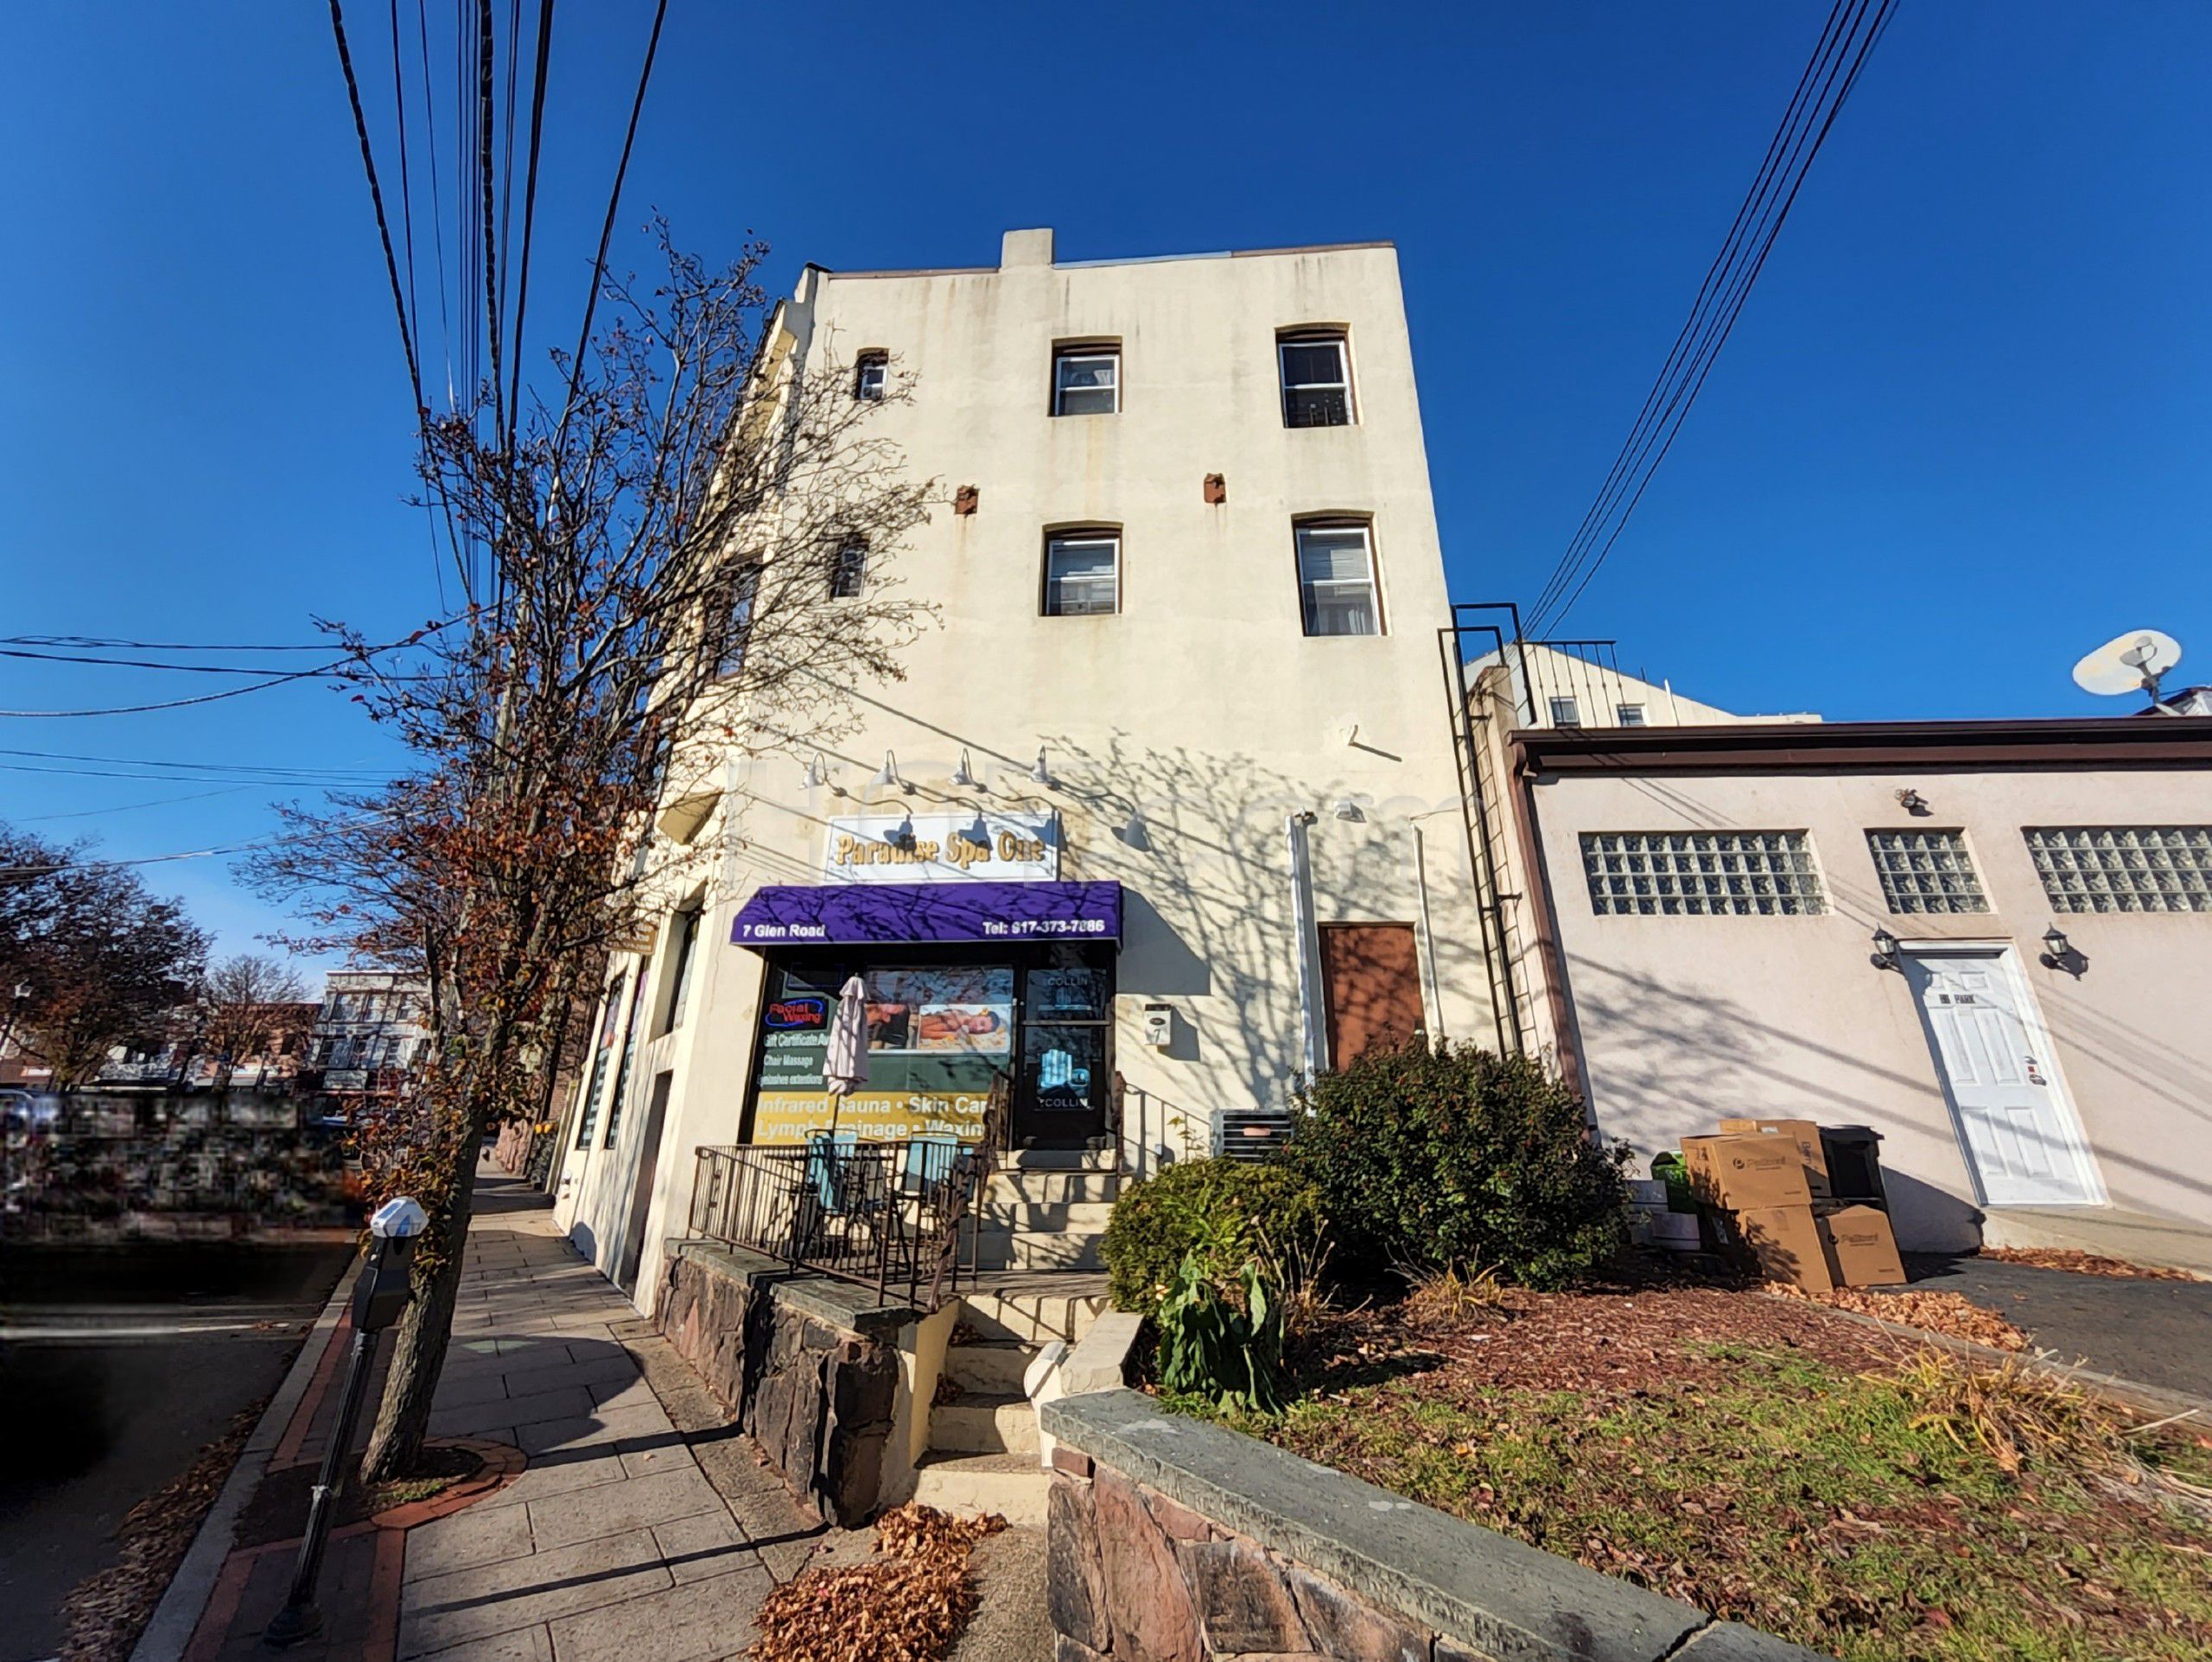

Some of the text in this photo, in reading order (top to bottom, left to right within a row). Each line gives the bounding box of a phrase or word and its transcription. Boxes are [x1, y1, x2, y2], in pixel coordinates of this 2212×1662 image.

[945, 831, 990, 869] Spa
[998, 831, 1045, 862] One
[743, 923, 825, 938] 7 Glen Road
[982, 921, 1008, 935] Tel:
[757, 1095, 988, 1114] Infrared Sauna Skin Car
[925, 1119, 985, 1137] Waxin
